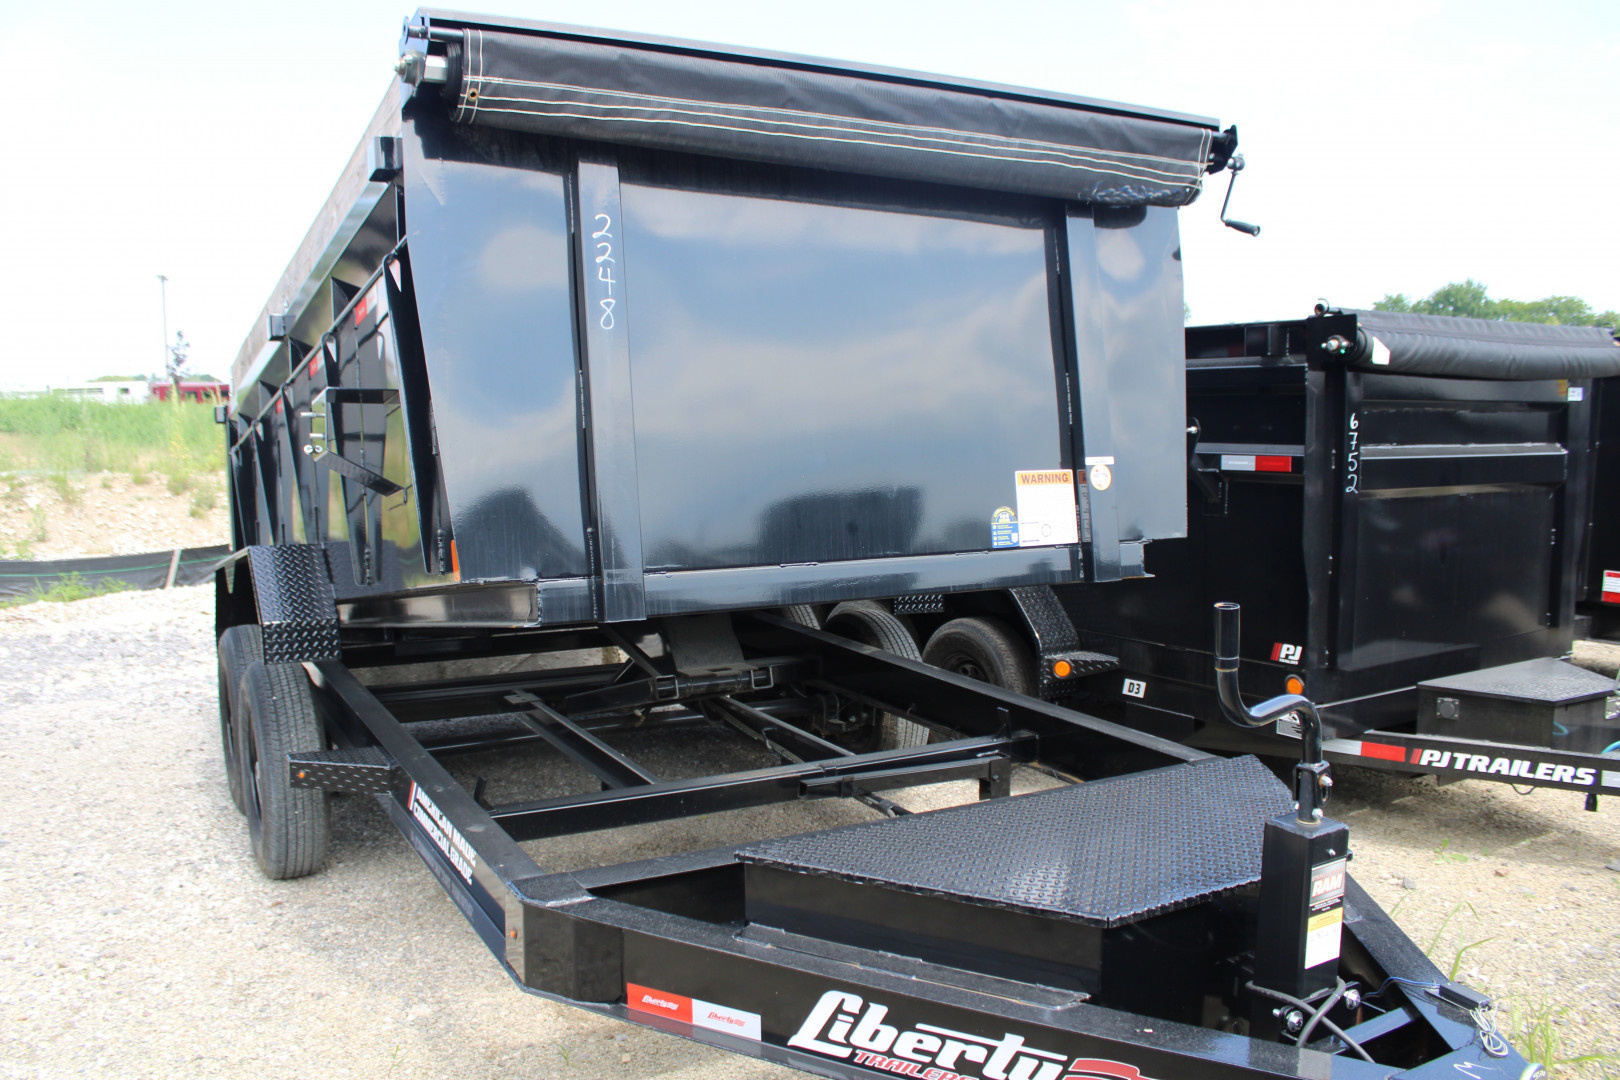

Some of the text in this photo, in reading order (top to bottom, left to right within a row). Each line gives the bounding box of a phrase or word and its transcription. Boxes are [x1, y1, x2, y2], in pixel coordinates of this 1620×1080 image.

[592, 213, 616, 330] 2248
[1345, 412, 1359, 494] 6752
[1021, 473, 1068, 484] WARNING
[1279, 643, 1303, 661] PJ
[1127, 681, 1141, 695] D3
[1419, 749, 1597, 786] PJ TRAILERS
[416, 786, 477, 868] AMERICAN MADE
[413, 801, 473, 886] COMMERCIAL GRADE
[1312, 872, 1344, 898] RAM
[641, 994, 668, 1008] Liberty
[707, 1011, 734, 1025] Liberty
[787, 990, 1068, 1080] Liberty
